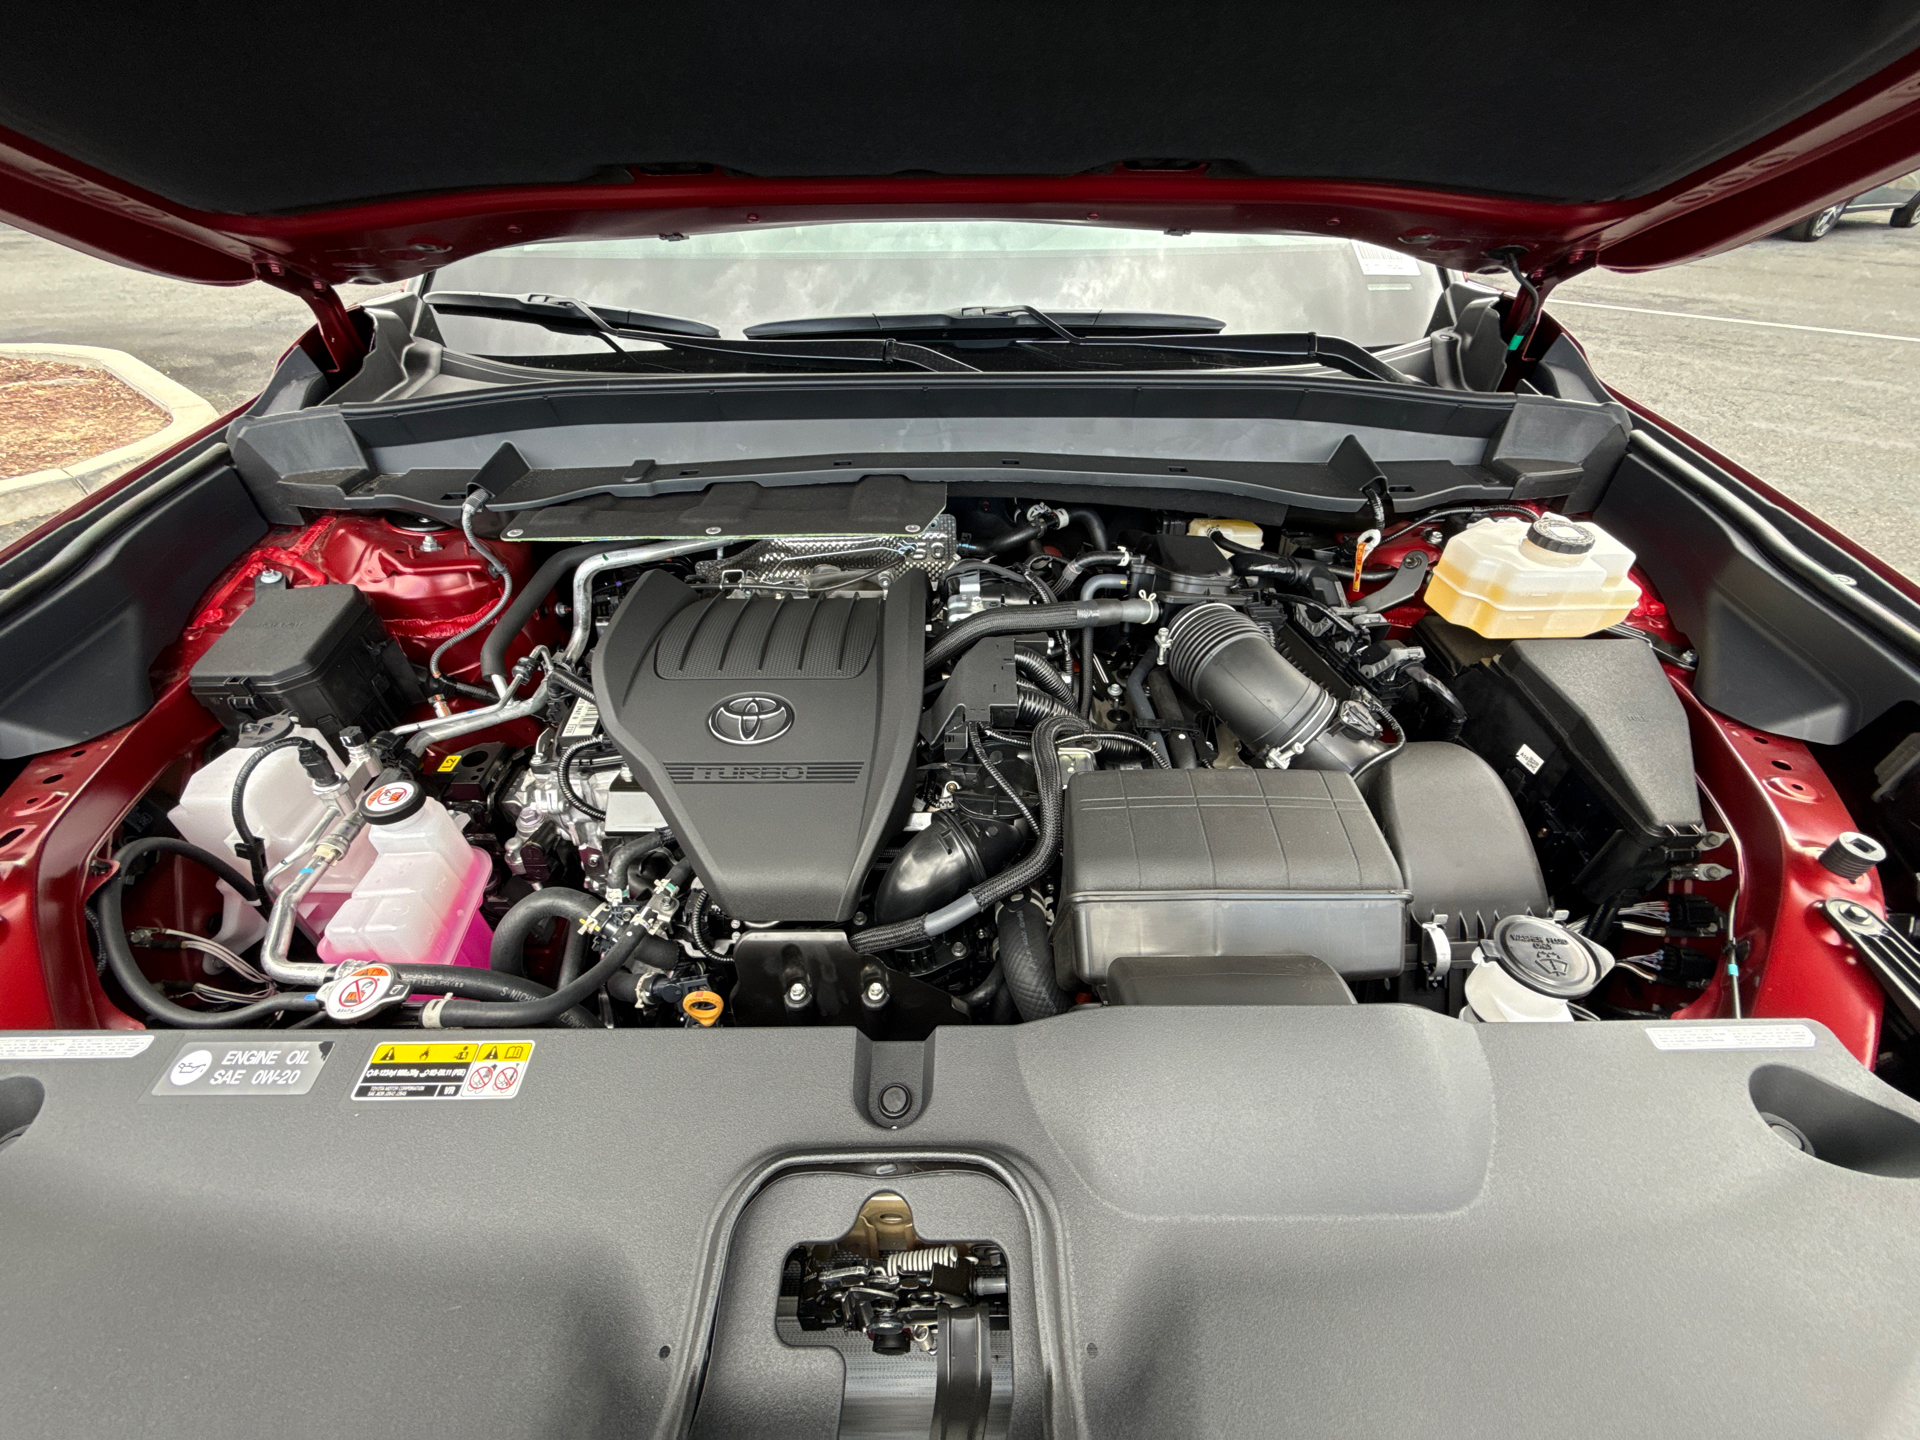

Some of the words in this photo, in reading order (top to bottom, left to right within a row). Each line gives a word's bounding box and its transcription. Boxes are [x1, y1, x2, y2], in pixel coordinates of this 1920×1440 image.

[697, 766, 804, 780] TURBO
[221, 1050, 282, 1065] ENGINE
[285, 1050, 310, 1065] OIL
[209, 1069, 247, 1085] SAE
[251, 1069, 301, 1085] 0W-20
